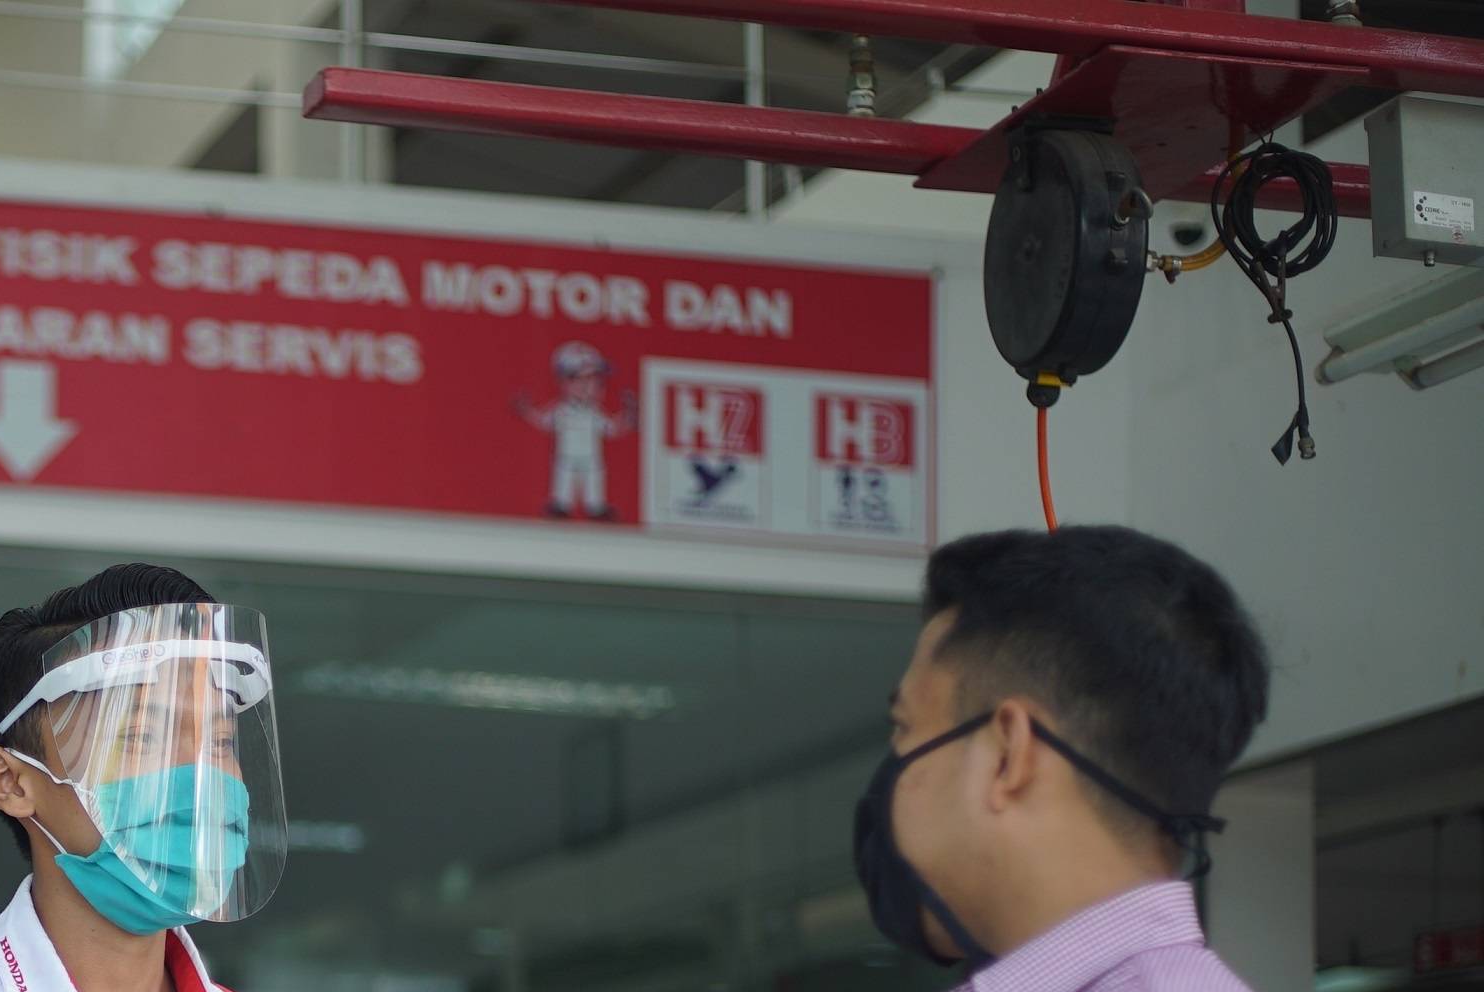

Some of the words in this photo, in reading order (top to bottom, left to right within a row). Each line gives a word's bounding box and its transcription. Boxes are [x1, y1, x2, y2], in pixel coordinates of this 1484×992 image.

[151, 239, 411, 307] SEPEDA
[421, 260, 651, 328] MOTOR
[664, 280, 793, 339] DAN
[183, 317, 422, 384] SERVIS
